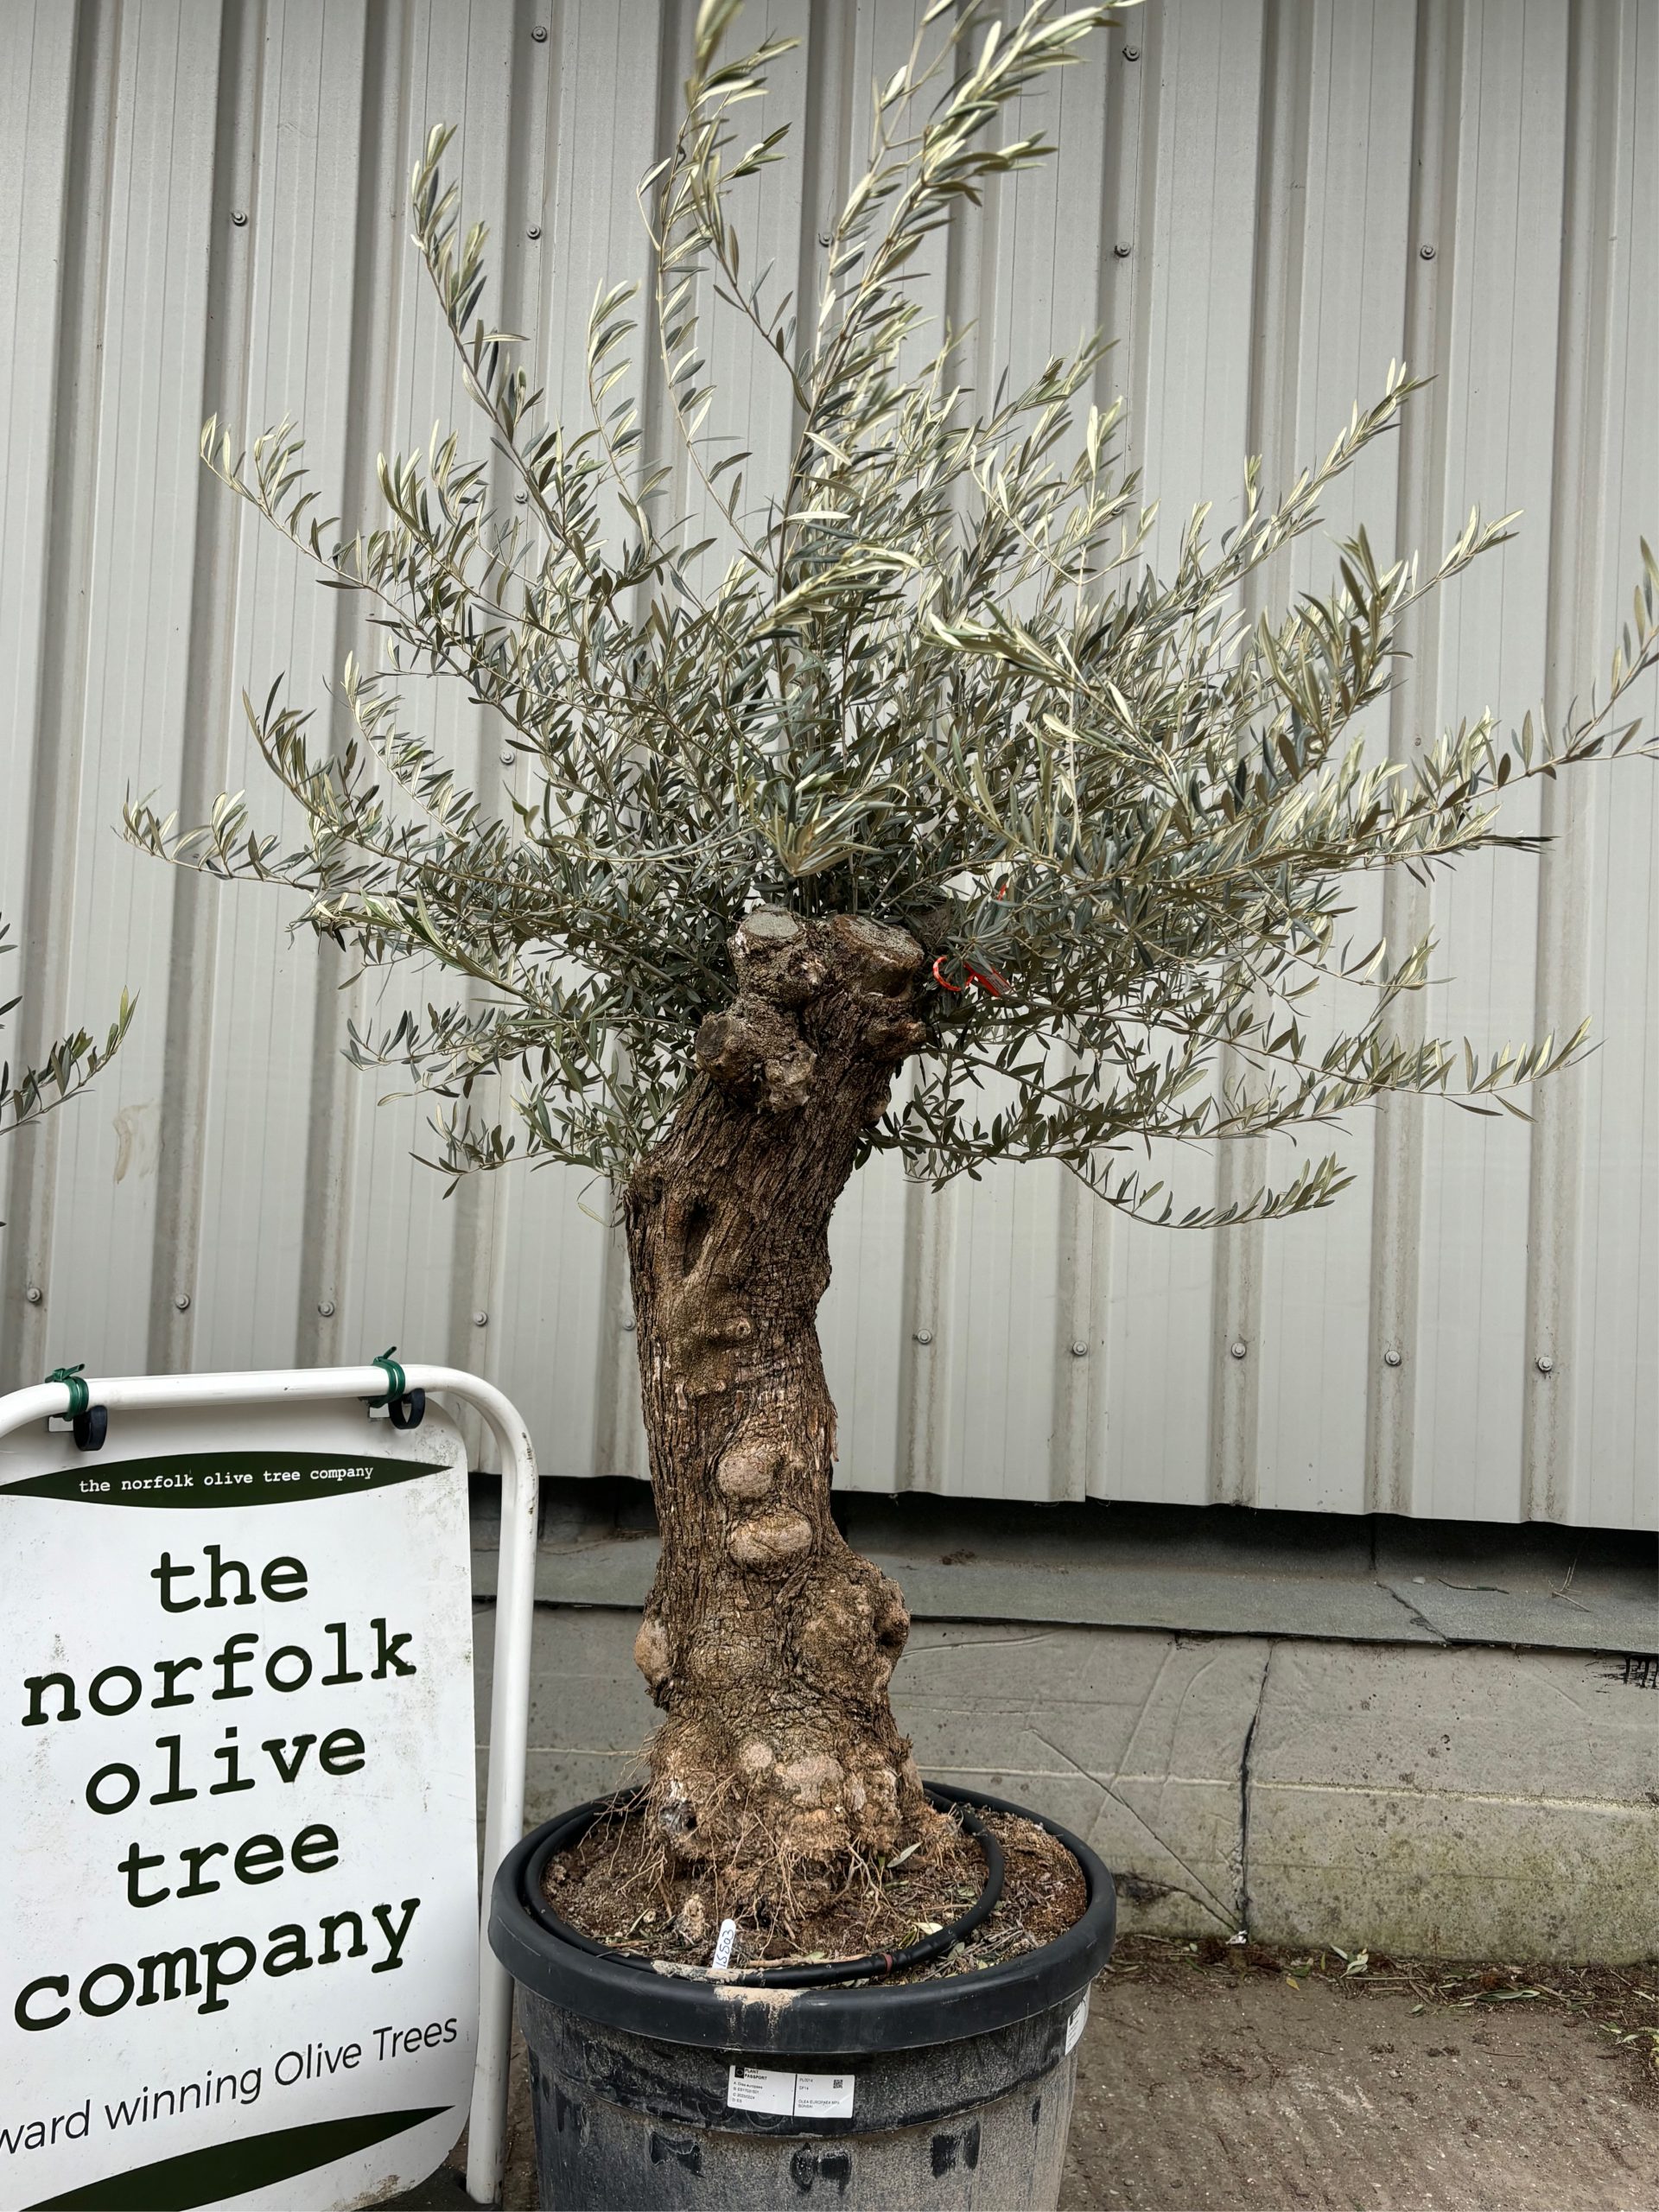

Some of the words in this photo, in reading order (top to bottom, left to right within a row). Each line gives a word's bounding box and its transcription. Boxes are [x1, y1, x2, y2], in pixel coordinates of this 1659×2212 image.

[79, 1478, 111, 1493] the
[121, 1473, 194, 1491] norfolk
[203, 1471, 253, 1485] olive
[263, 1470, 301, 1483] tree
[309, 1466, 374, 1481] company
[150, 1544, 308, 1613] the
[21, 1618, 417, 1727] norfolk
[86, 1726, 365, 1815] olive
[117, 1823, 339, 1909] tree
[14, 1897, 421, 2031] company
[105, 2068, 262, 2130] winning
[275, 2041, 362, 2086] Olive
[372, 2018, 458, 2061] Trees
